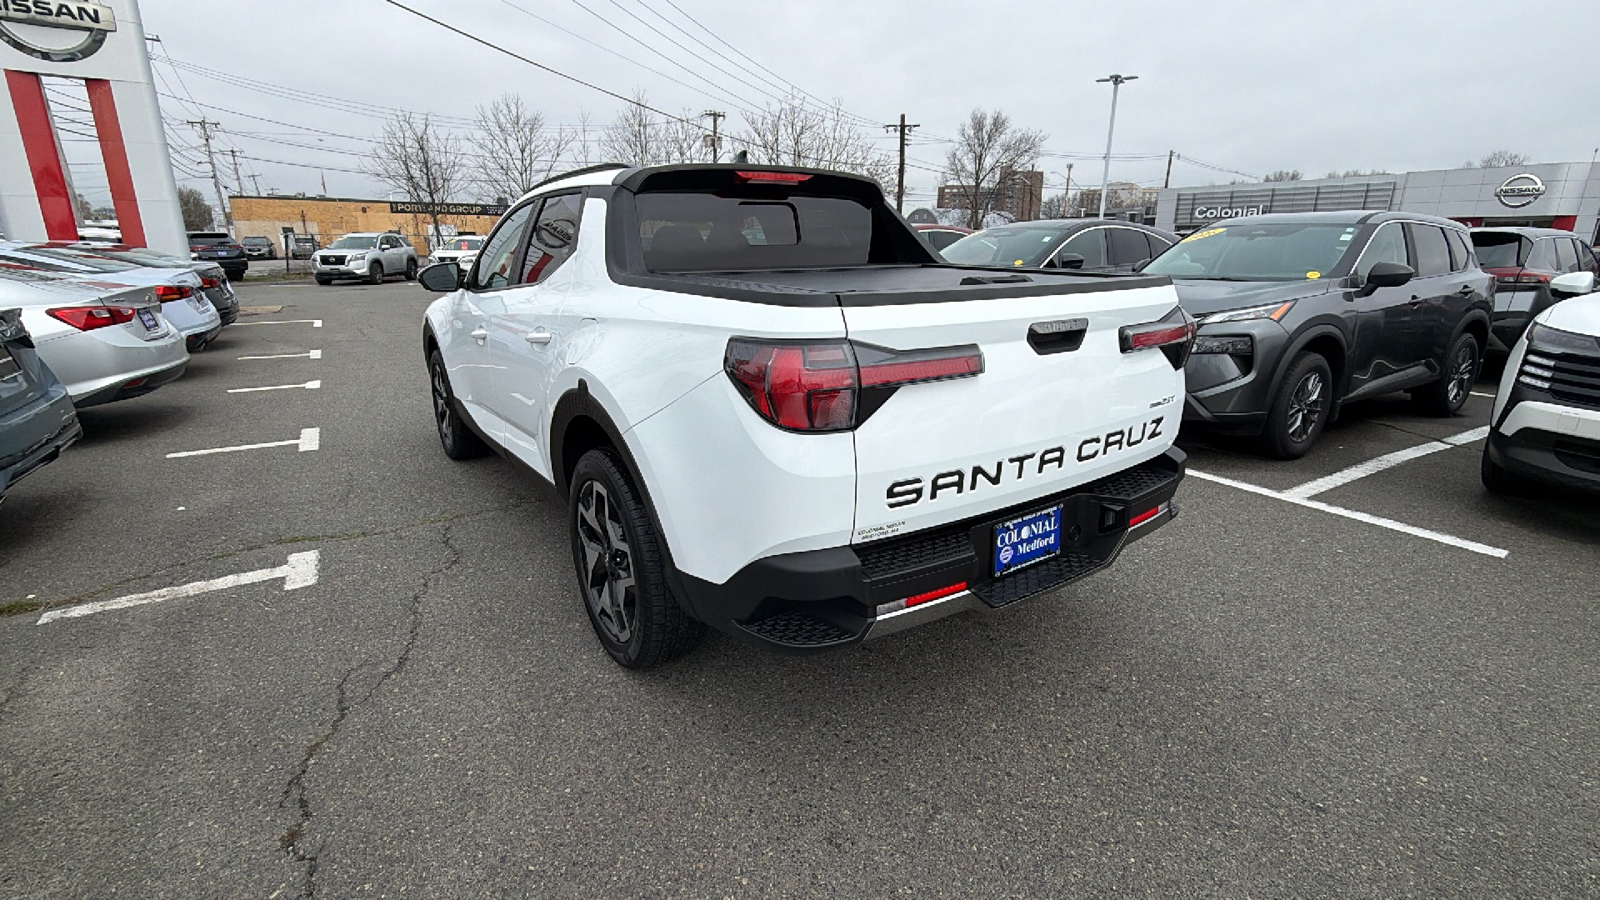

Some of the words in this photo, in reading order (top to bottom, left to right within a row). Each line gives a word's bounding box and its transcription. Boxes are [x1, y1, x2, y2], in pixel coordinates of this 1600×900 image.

[0, 0, 101, 24] ISSAN
[449, 205, 482, 214] GROUP
[1195, 204, 1263, 218] Colonial
[886, 445, 1066, 509] SANTA
[1076, 416, 1164, 462] CRUZ
[997, 516, 1059, 548] COLONIAL
[1017, 533, 1055, 556] Medford
